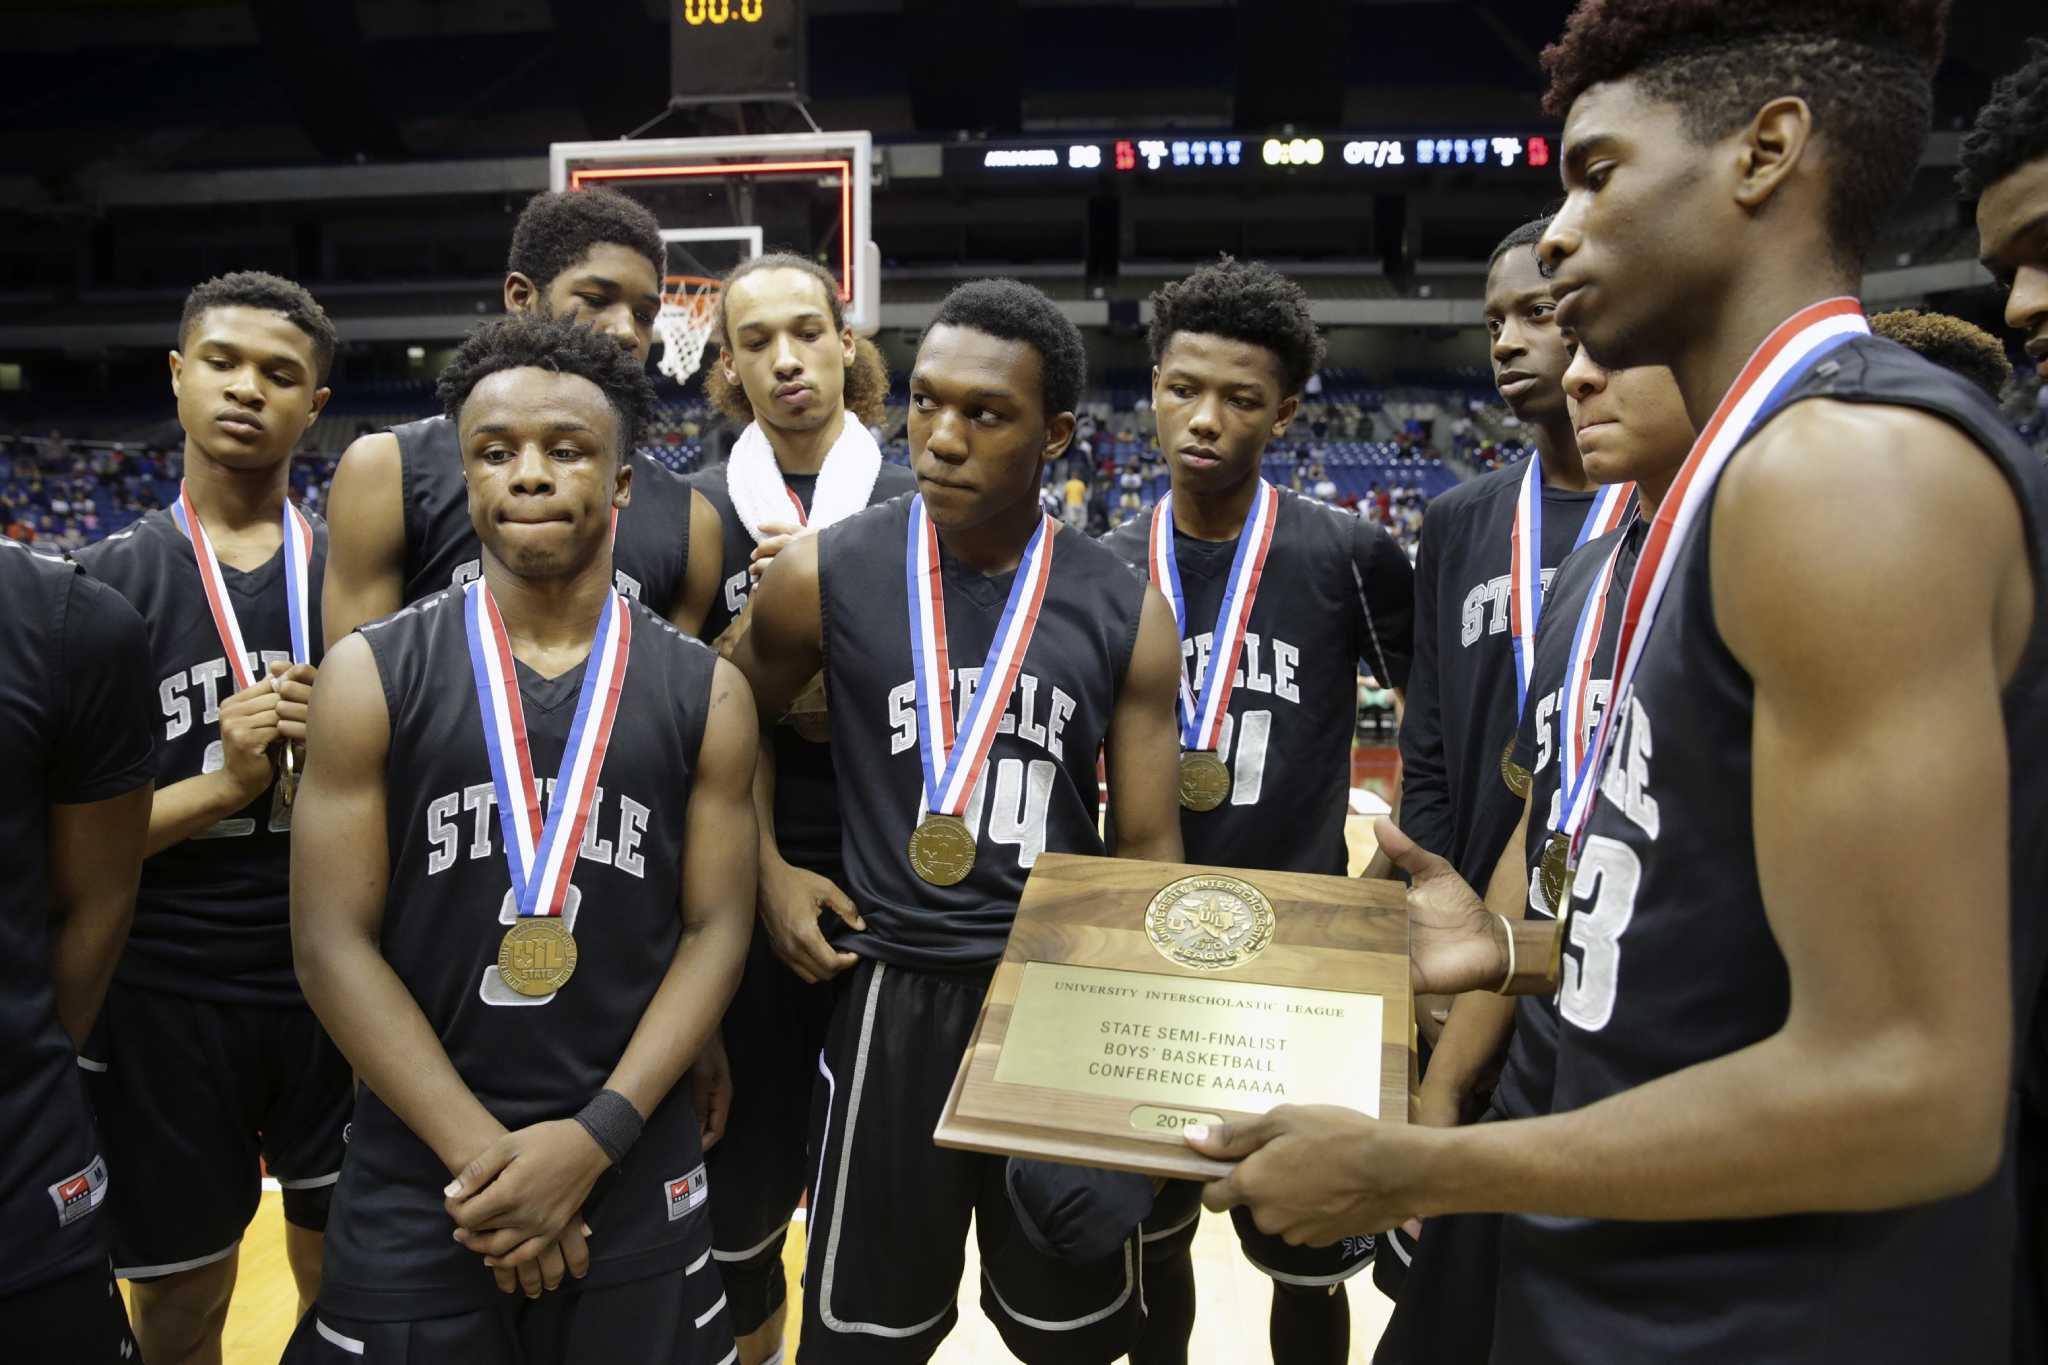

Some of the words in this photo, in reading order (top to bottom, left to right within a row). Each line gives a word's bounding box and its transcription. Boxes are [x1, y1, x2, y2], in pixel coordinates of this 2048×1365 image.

[1263, 138, 1324, 165] 0:00
[1344, 140, 1405, 168] OT/1
[1200, 910, 1224, 928] UIL
[1054, 981, 1139, 998] UNIVERSITY
[1145, 990, 1273, 1011] INTERSCHOLASTIC
[1286, 1004, 1345, 1018] LEAGUE
[1100, 1020, 1151, 1038] STATE
[1156, 1027, 1288, 1051] SEMI-FINALIST
[1104, 1041, 1156, 1060] BOYS'
[1162, 1048, 1275, 1073] BASKETBALL
[1088, 1061, 1206, 1088] CONFERENCE
[1212, 1075, 1287, 1096] AAAAAA
